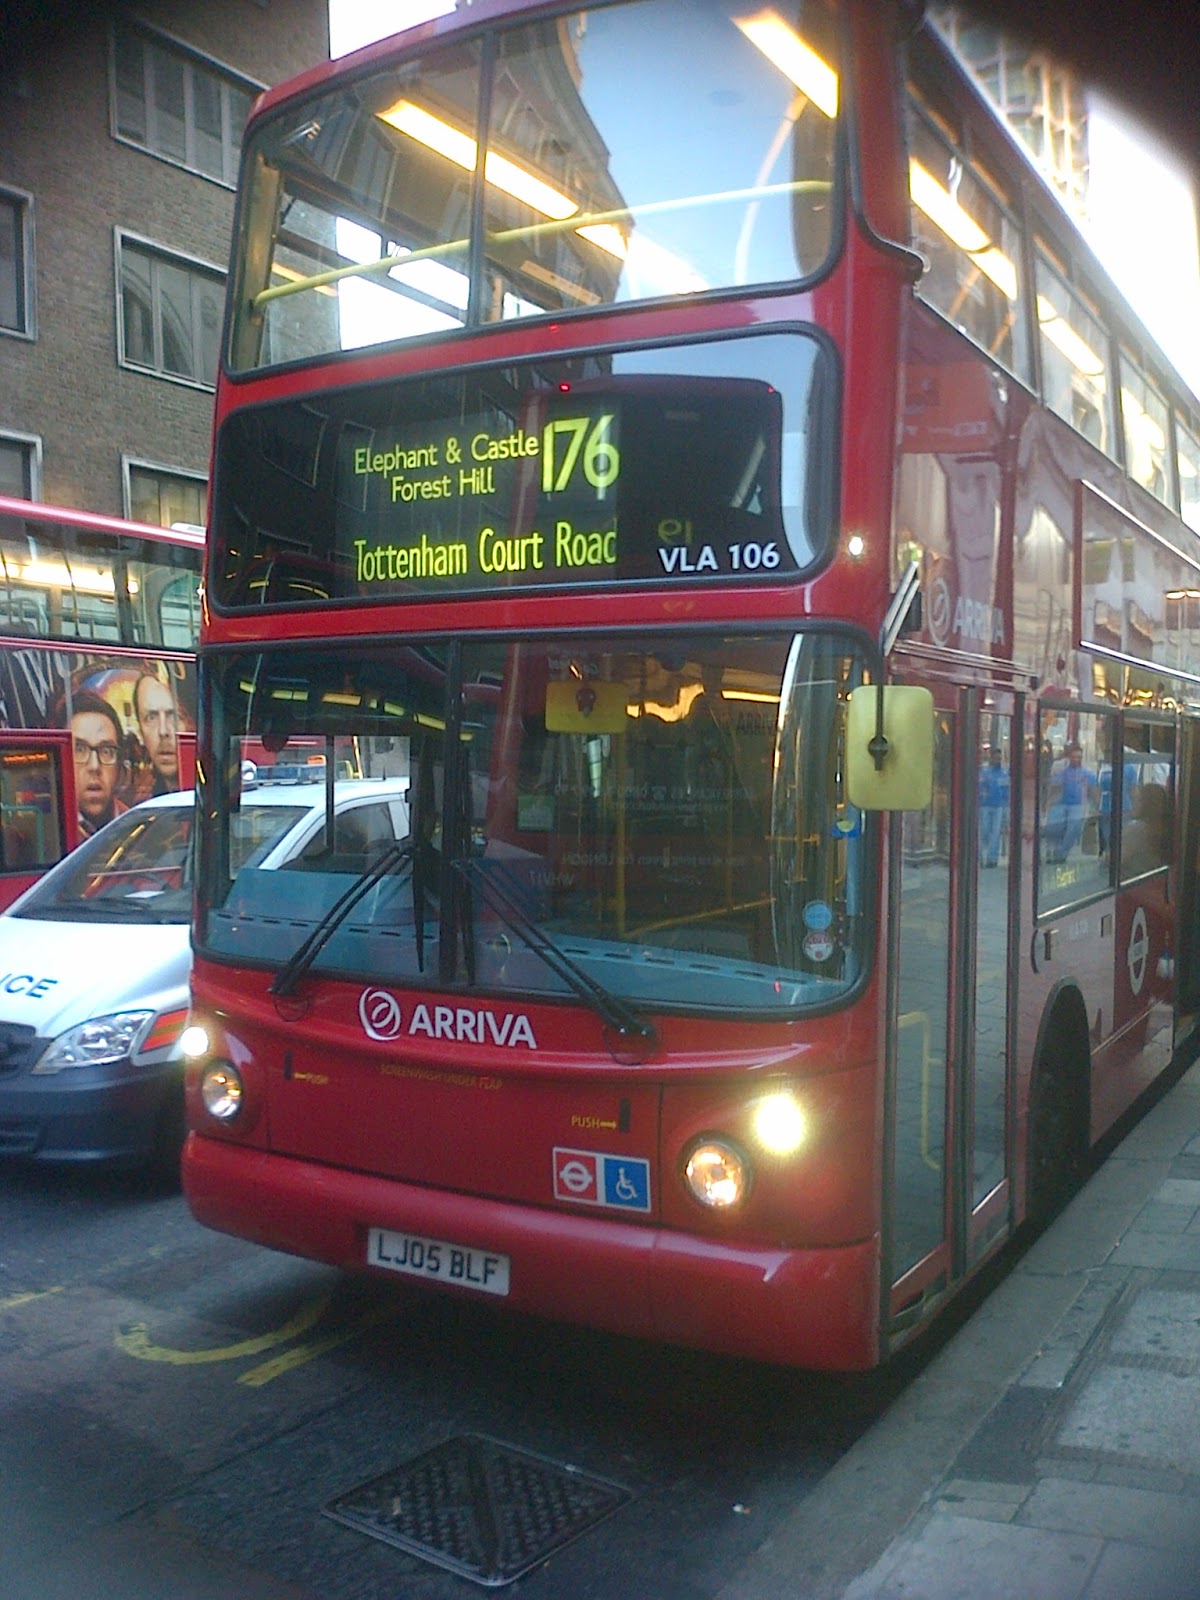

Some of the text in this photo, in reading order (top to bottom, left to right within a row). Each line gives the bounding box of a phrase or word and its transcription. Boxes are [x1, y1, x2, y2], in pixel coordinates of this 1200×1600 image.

[354, 430, 539, 478] Elephant & Castle
[542, 414, 621, 494] 176
[391, 466, 495, 503] Forest Hill
[354, 535, 468, 582] Tottenham
[479, 527, 544, 574] Court
[658, 542, 780, 573] VLA 106
[408, 1003, 538, 1050] ARRIVA
[571, 1115, 600, 1129] PUSH
[377, 1236, 500, 1286] LJ05 BLF
